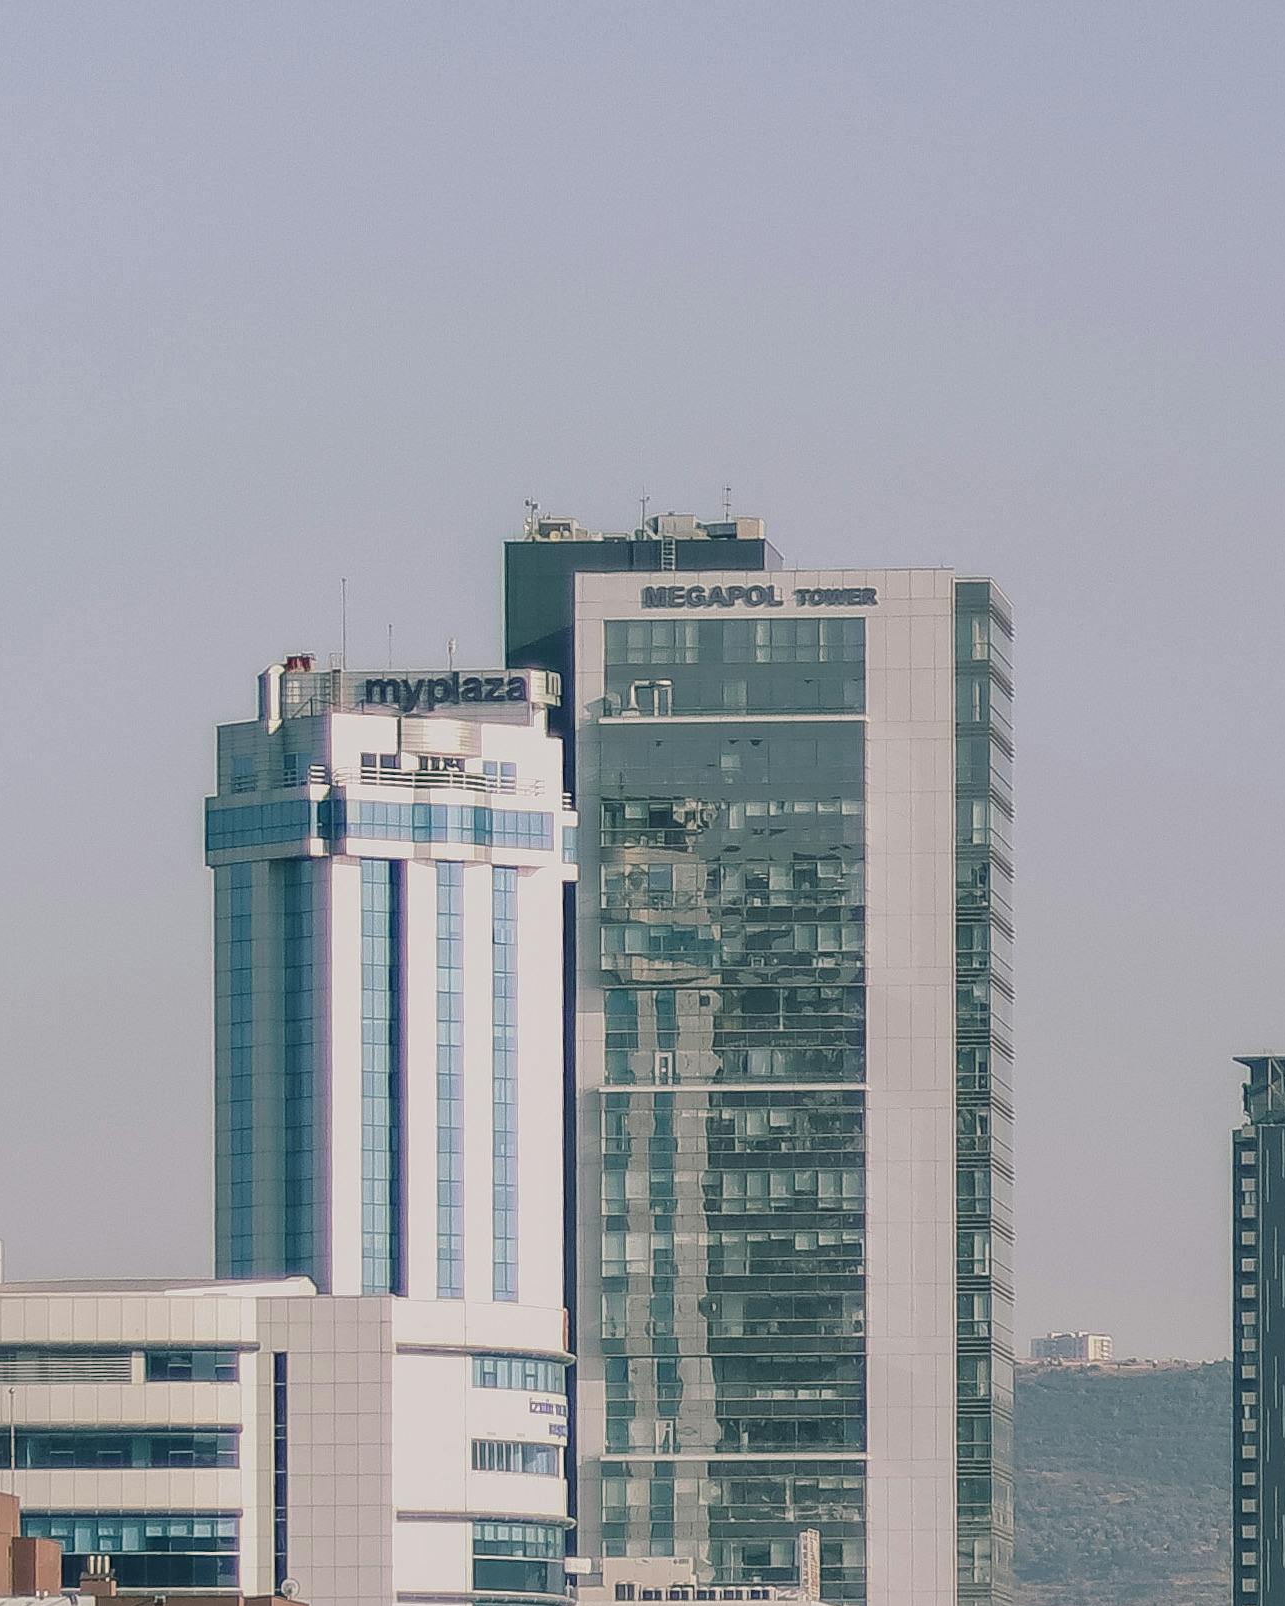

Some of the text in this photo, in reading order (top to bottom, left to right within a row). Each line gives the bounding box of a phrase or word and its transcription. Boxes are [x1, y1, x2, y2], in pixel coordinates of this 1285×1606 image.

[641, 585, 879, 608] MEGAPOL TOWER
[365, 671, 528, 712] myplaza
